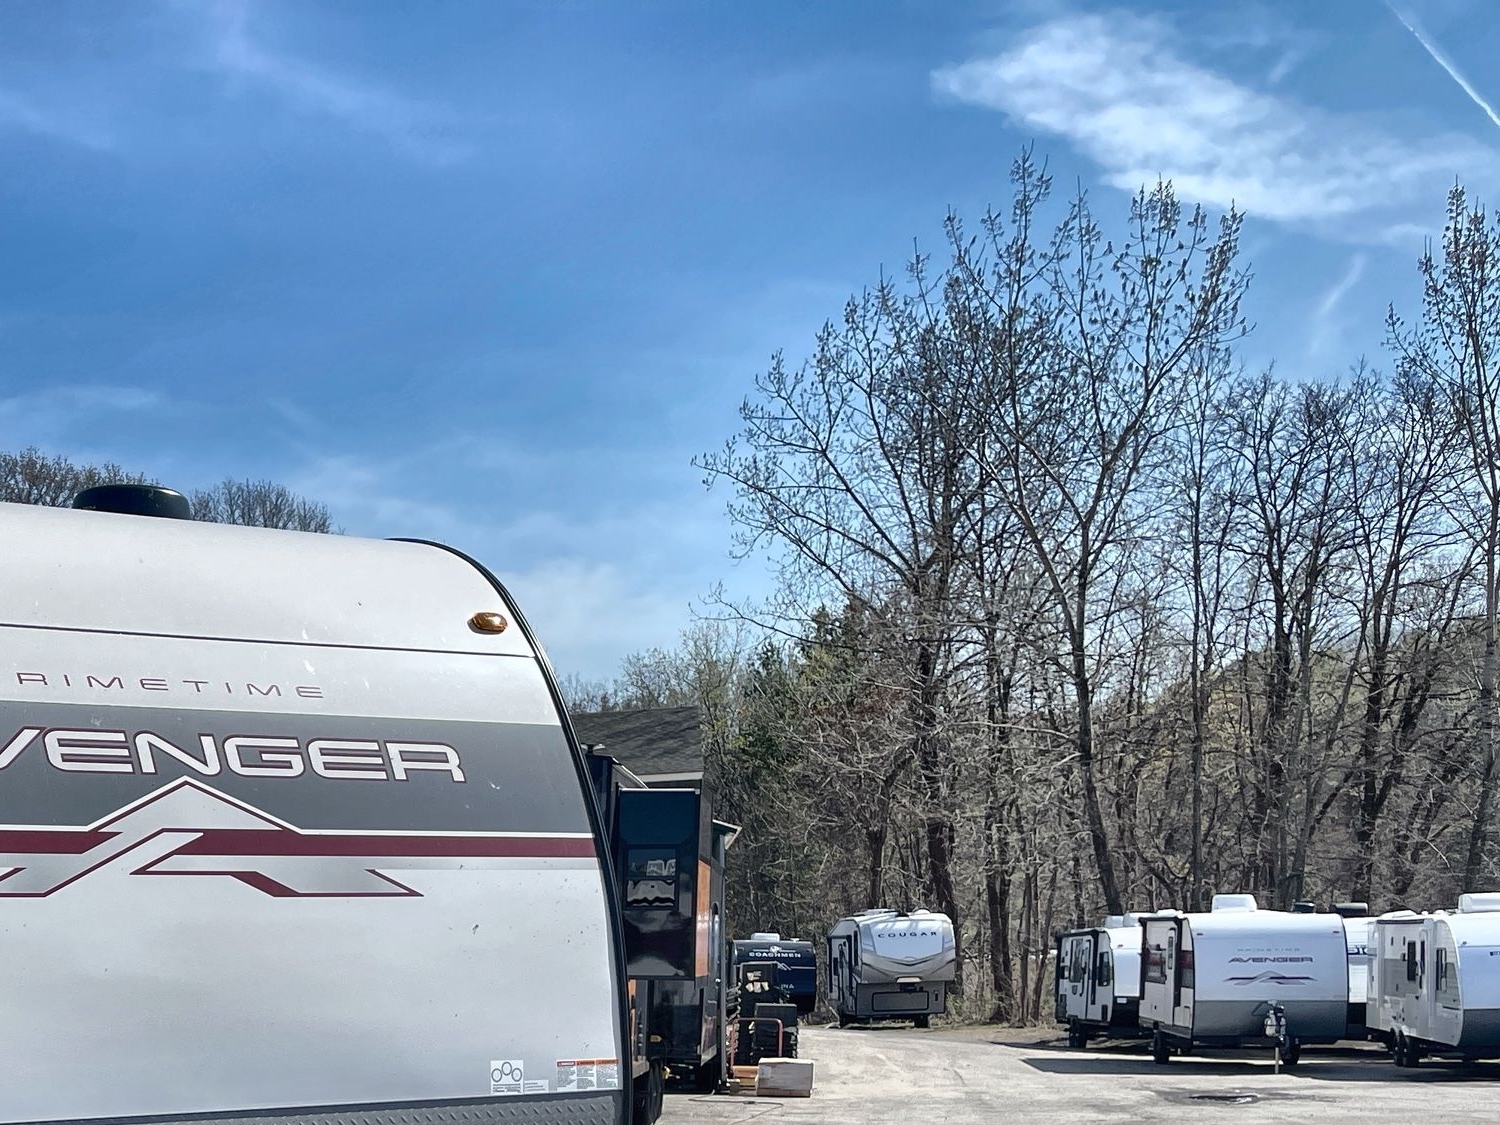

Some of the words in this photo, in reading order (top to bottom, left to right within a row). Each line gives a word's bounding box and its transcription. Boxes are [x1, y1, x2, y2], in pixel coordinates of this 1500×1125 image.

[877, 931, 938, 939] COUGAR
[748, 951, 802, 959] COACHMEN
[1228, 956, 1314, 964] AVENGER
